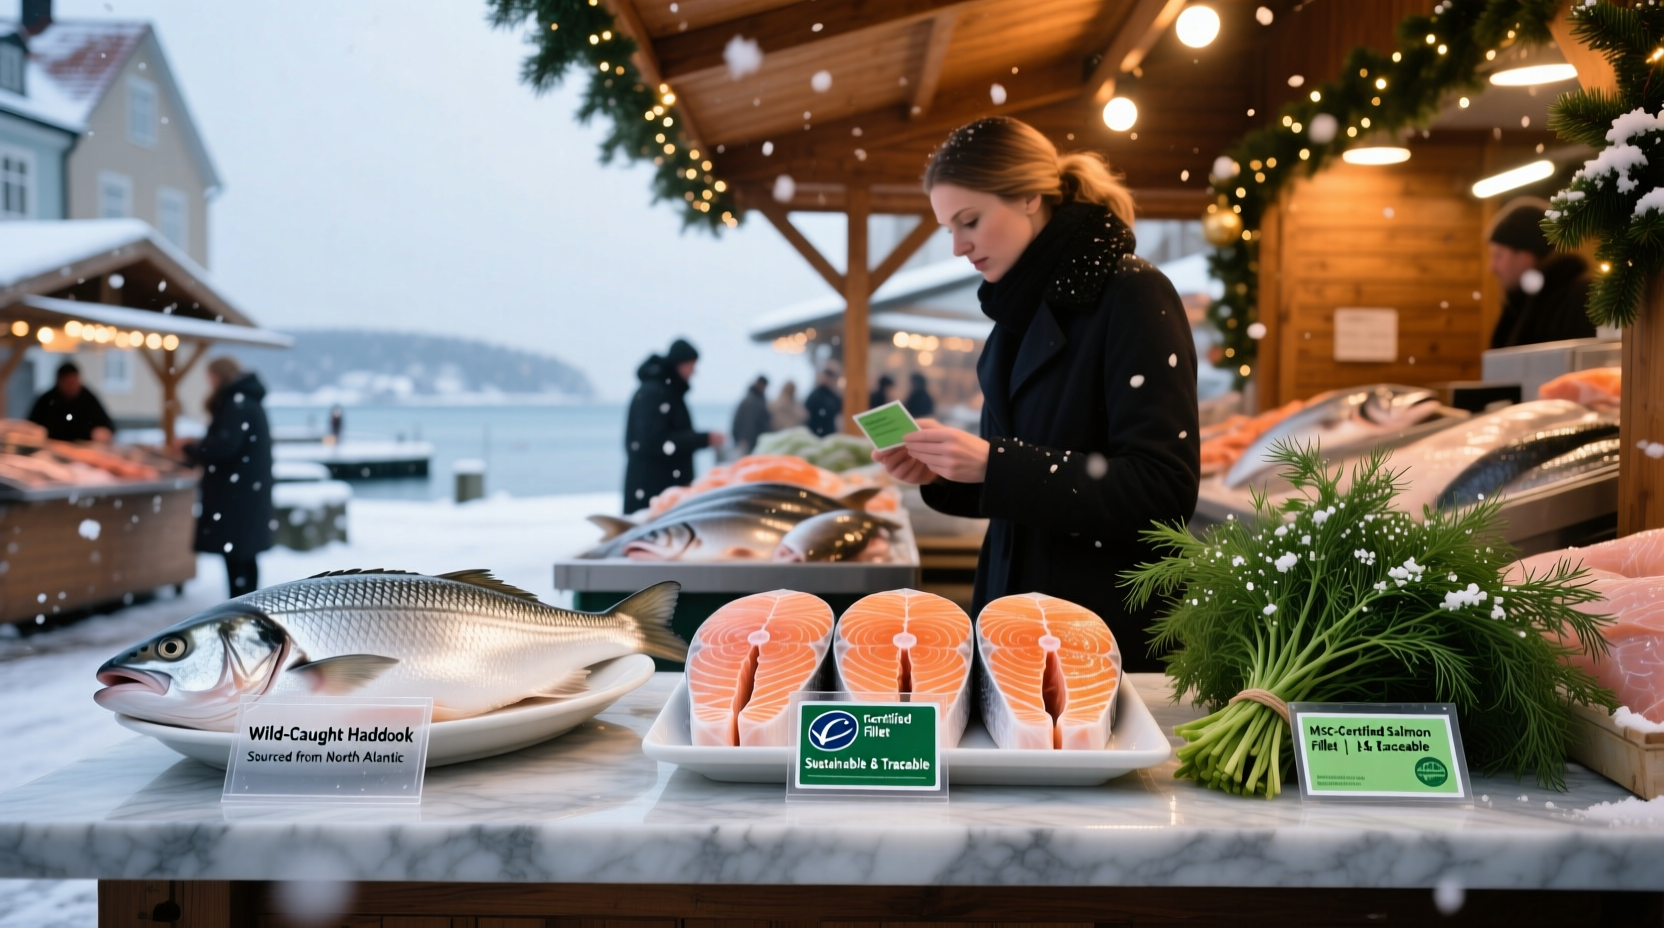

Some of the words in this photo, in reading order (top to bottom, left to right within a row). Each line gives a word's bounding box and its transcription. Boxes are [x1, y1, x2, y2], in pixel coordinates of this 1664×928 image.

[249, 725, 344, 746] Wild-Caught
[864, 726, 890, 737] Fillet
[1387, 726, 1431, 738] Salmon
[247, 750, 293, 763] Sourced
[296, 750, 323, 764] from
[326, 751, 360, 764] North
